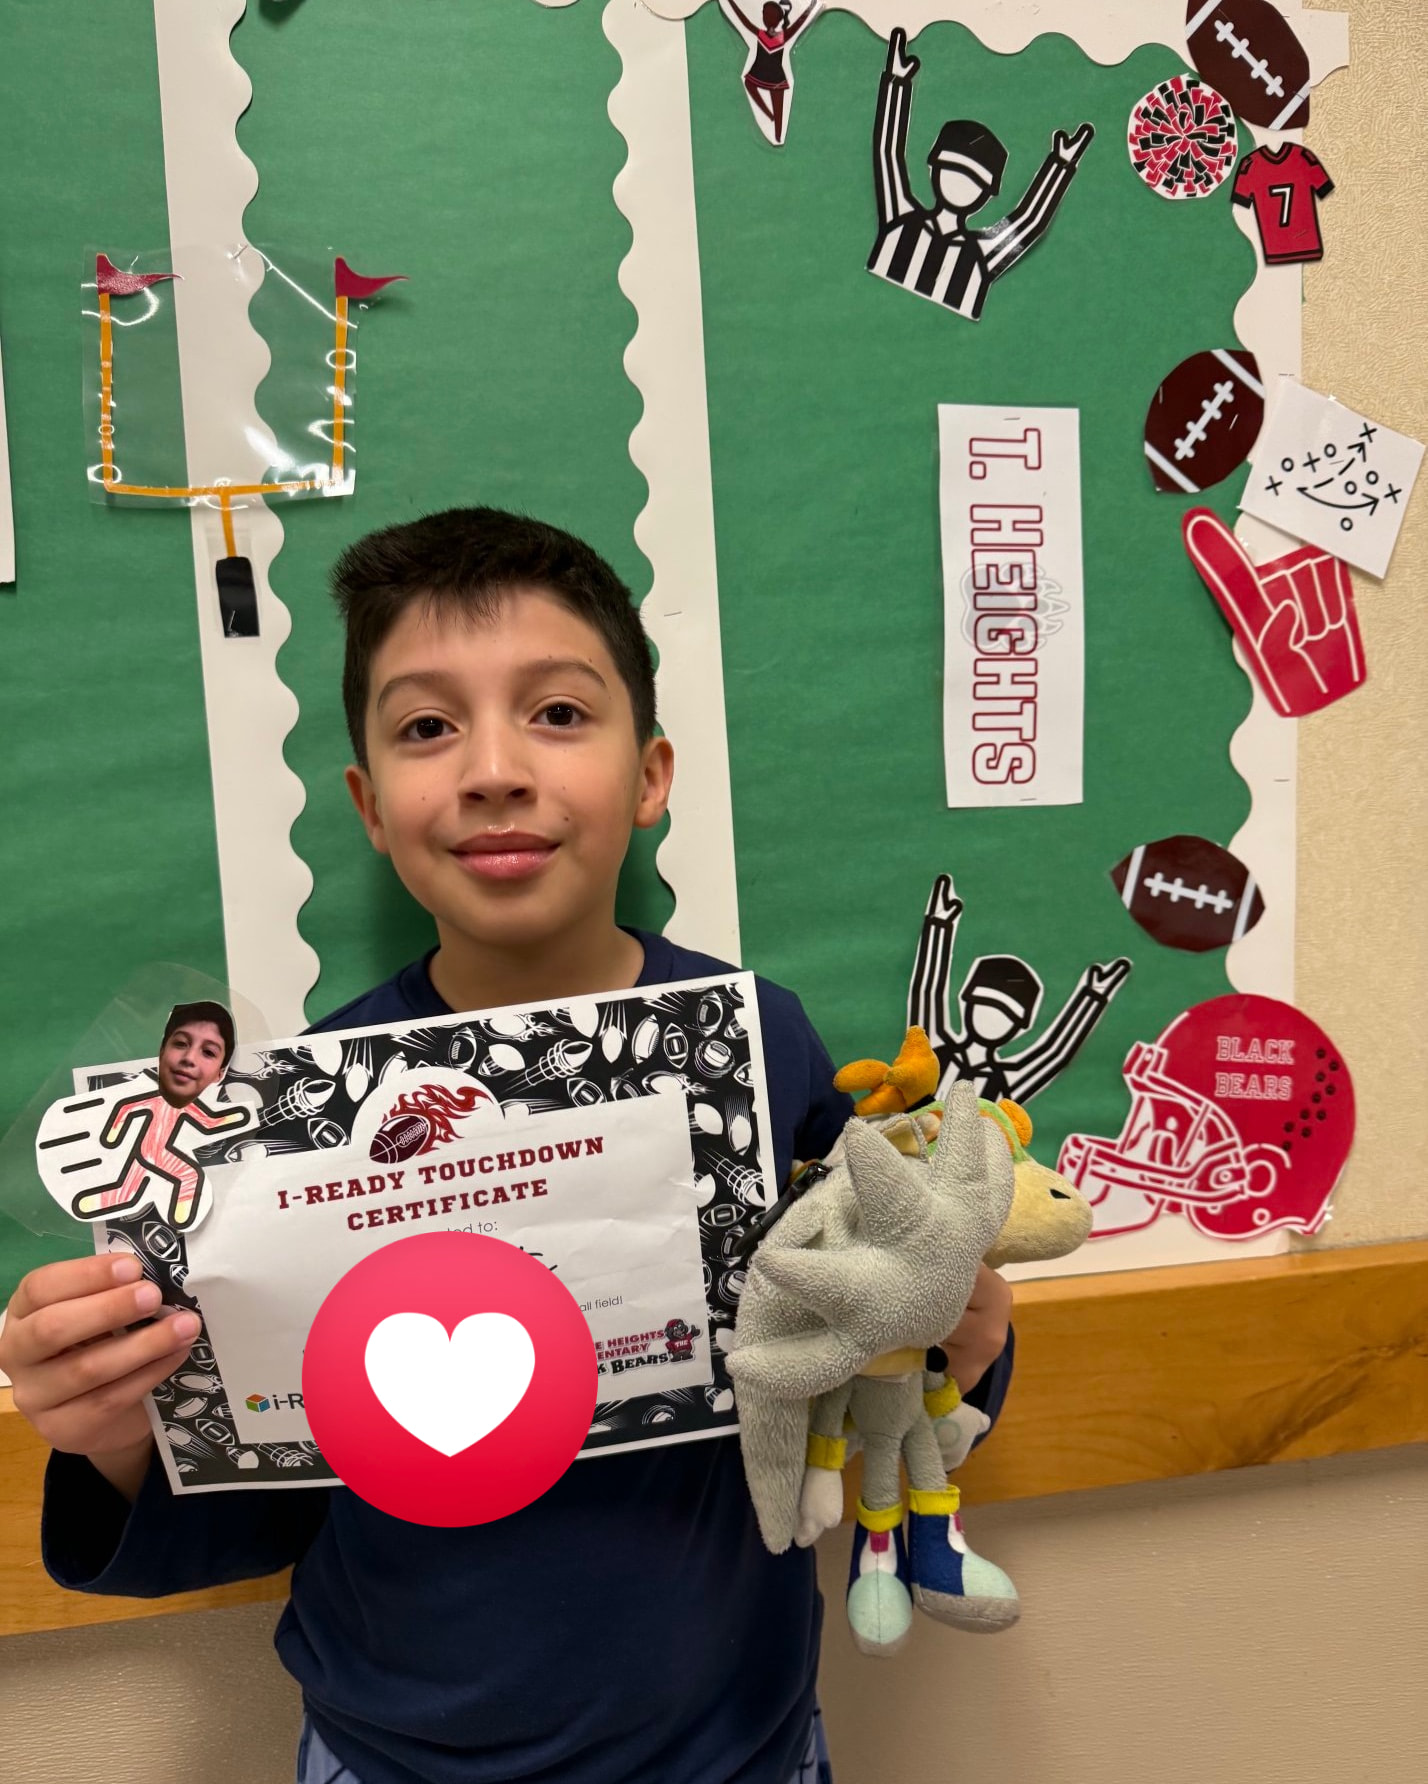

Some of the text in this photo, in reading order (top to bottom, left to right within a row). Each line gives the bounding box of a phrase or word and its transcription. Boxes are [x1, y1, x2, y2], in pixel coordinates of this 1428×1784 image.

[1269, 184, 1294, 227] 7
[969, 427, 1043, 785] T. HEIGHTS
[1216, 1035, 1295, 1065] BLACK
[1214, 1072, 1292, 1101] BEARS
[277, 1136, 604, 1210] I-READY TOUCHDOWN
[346, 1178, 549, 1232] CERTIFICATE
[478, 1220, 499, 1234] to:
[579, 1302, 592, 1313] all
[607, 1330, 664, 1348] HEIGHTS
[597, 1343, 650, 1361] ENTARY
[611, 1353, 669, 1374] BEARS
[272, 1393, 305, 1410] i-R
